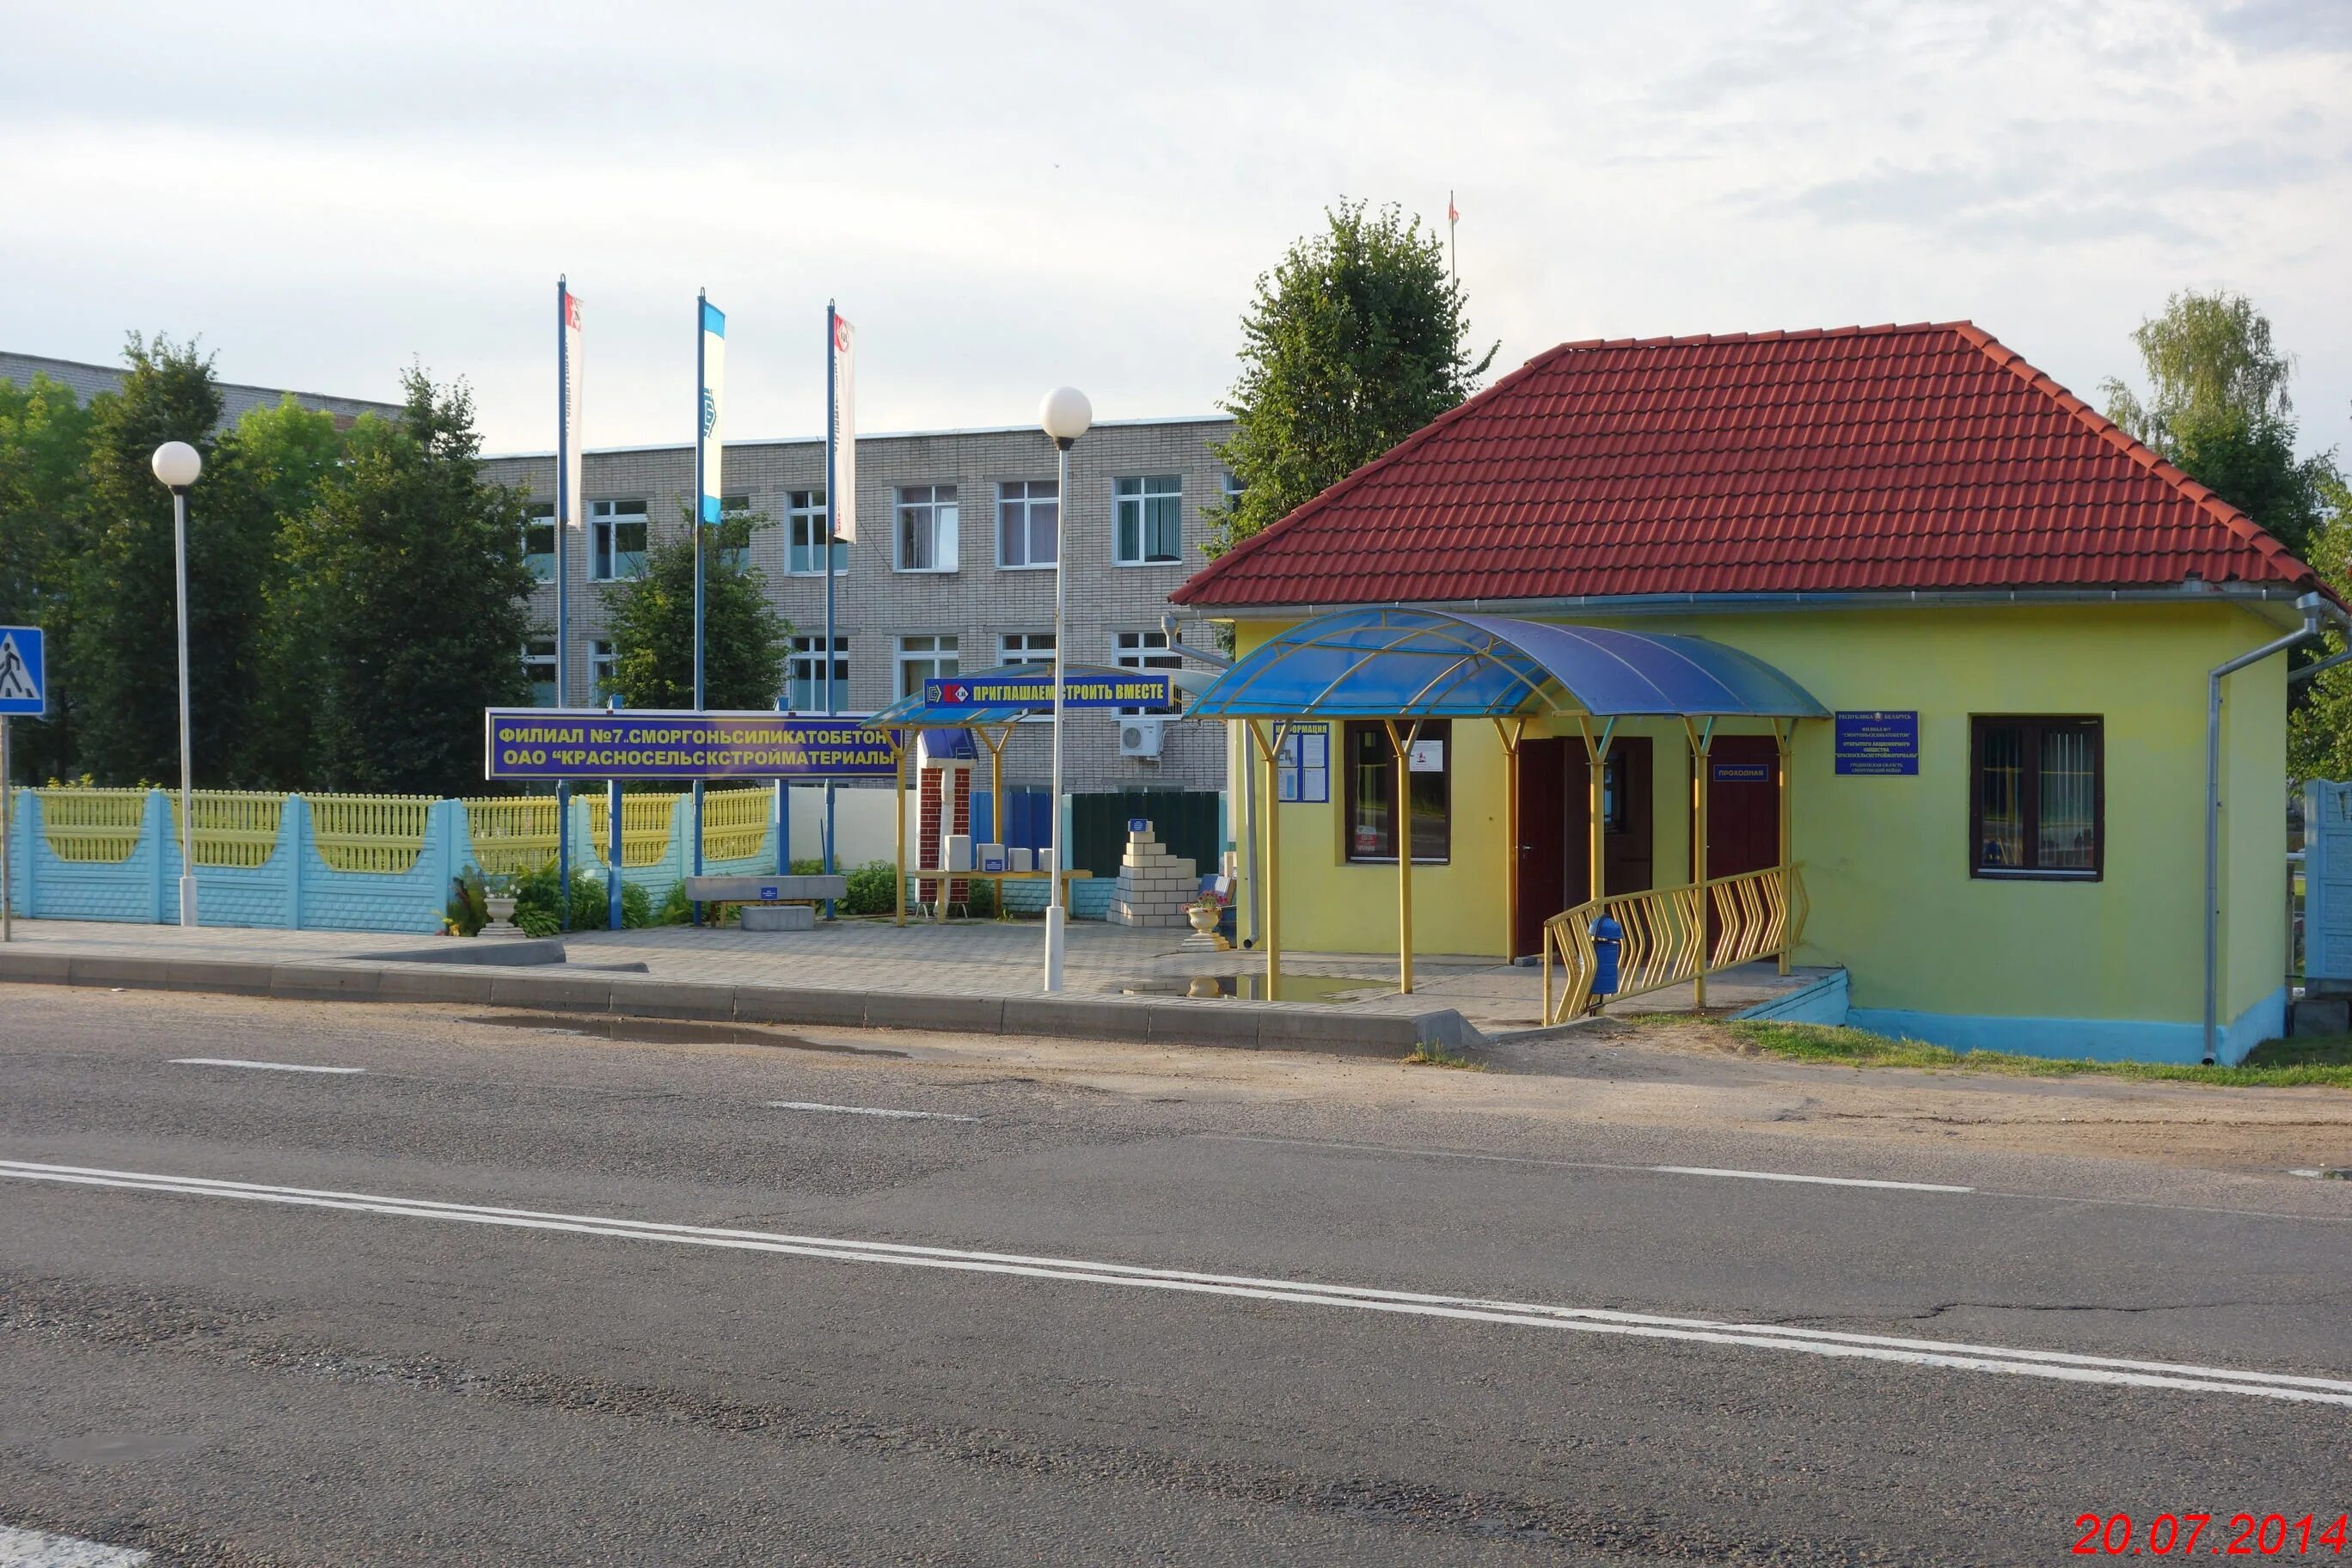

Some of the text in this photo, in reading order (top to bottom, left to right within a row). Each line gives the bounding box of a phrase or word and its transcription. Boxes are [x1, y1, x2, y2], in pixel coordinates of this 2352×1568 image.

[973, 685, 1055, 701] ПРИГЛАШАЕМ
[1116, 683, 1163, 700] ВМЕСТЕ
[499, 728, 584, 743] ФИЛИАЛ
[504, 750, 546, 765] ОАО
